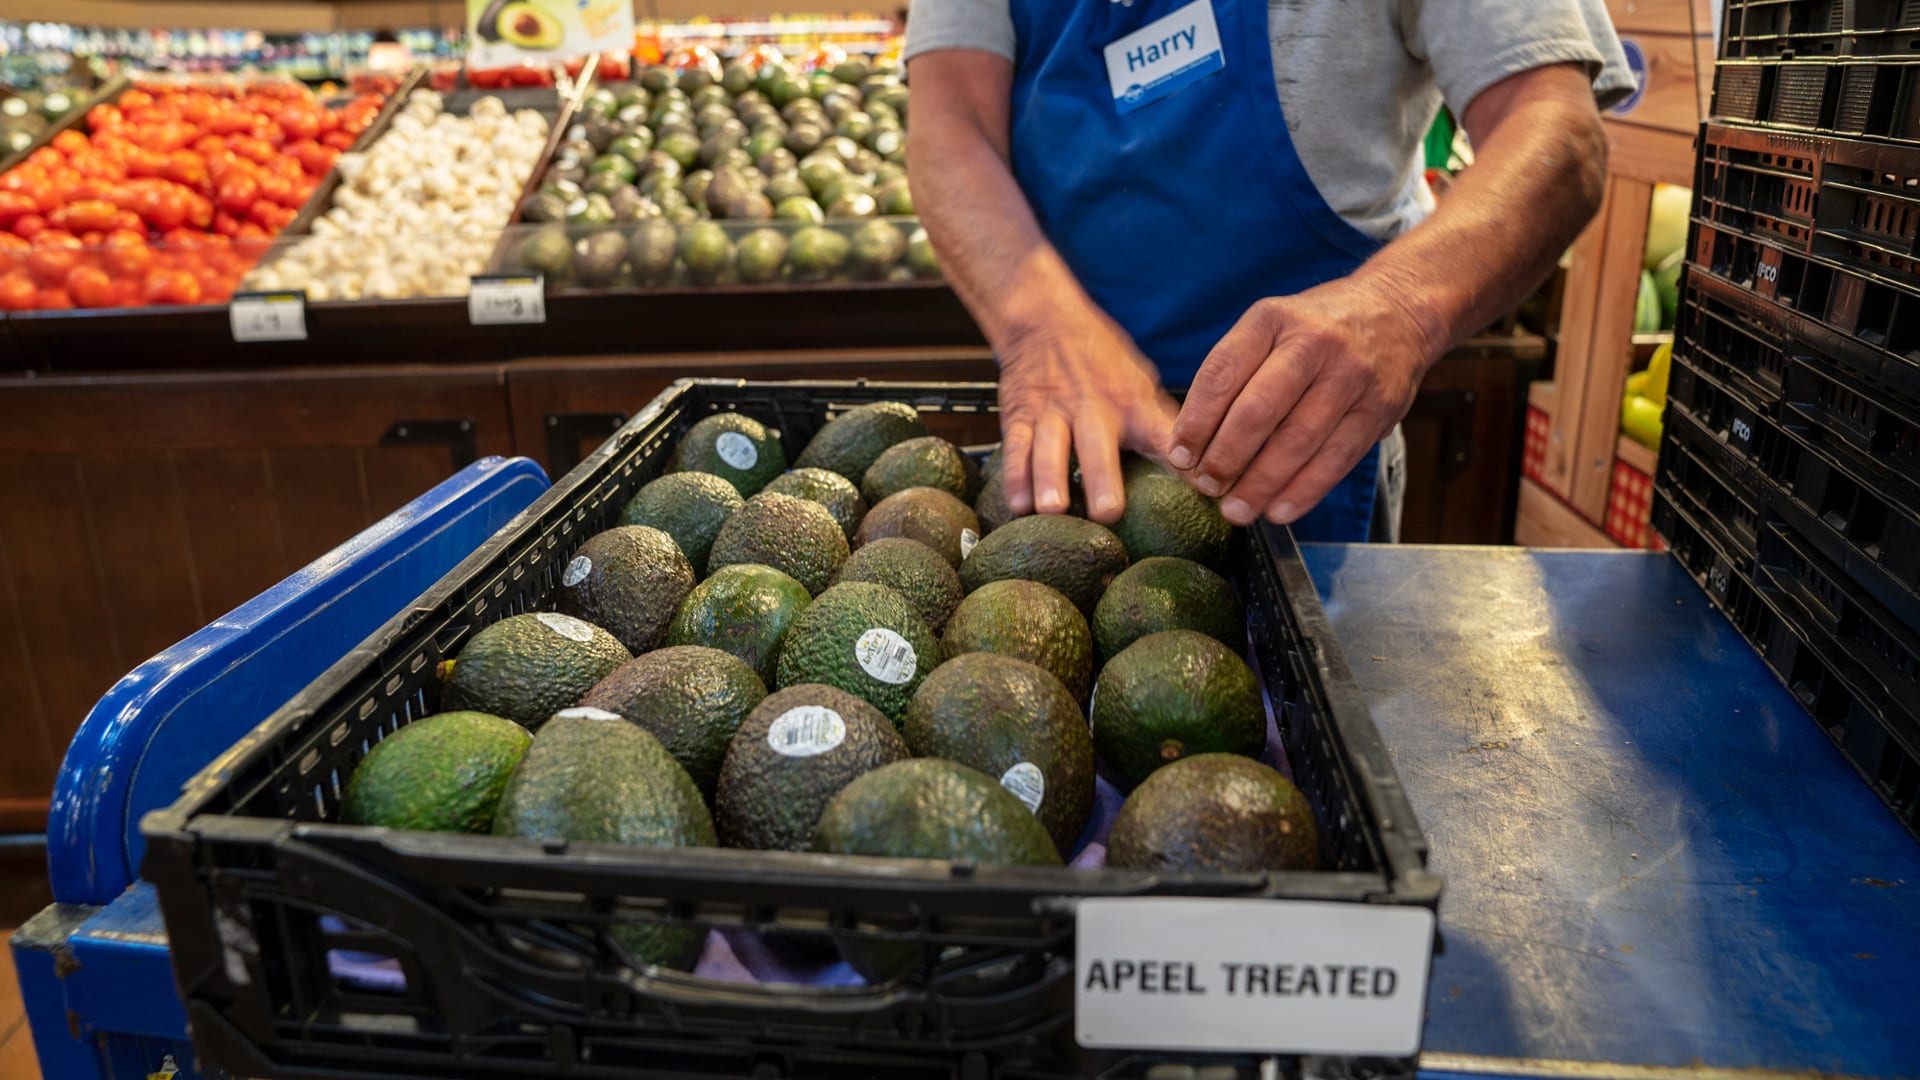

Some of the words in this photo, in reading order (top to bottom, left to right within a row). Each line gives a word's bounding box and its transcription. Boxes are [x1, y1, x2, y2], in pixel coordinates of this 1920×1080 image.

[1126, 24, 1196, 72] Harry
[1757, 262, 1777, 282] IFCO
[1732, 417, 1750, 442] IFCO
[1085, 958, 1206, 994] APEEL
[1221, 963, 1399, 999] TREATED
